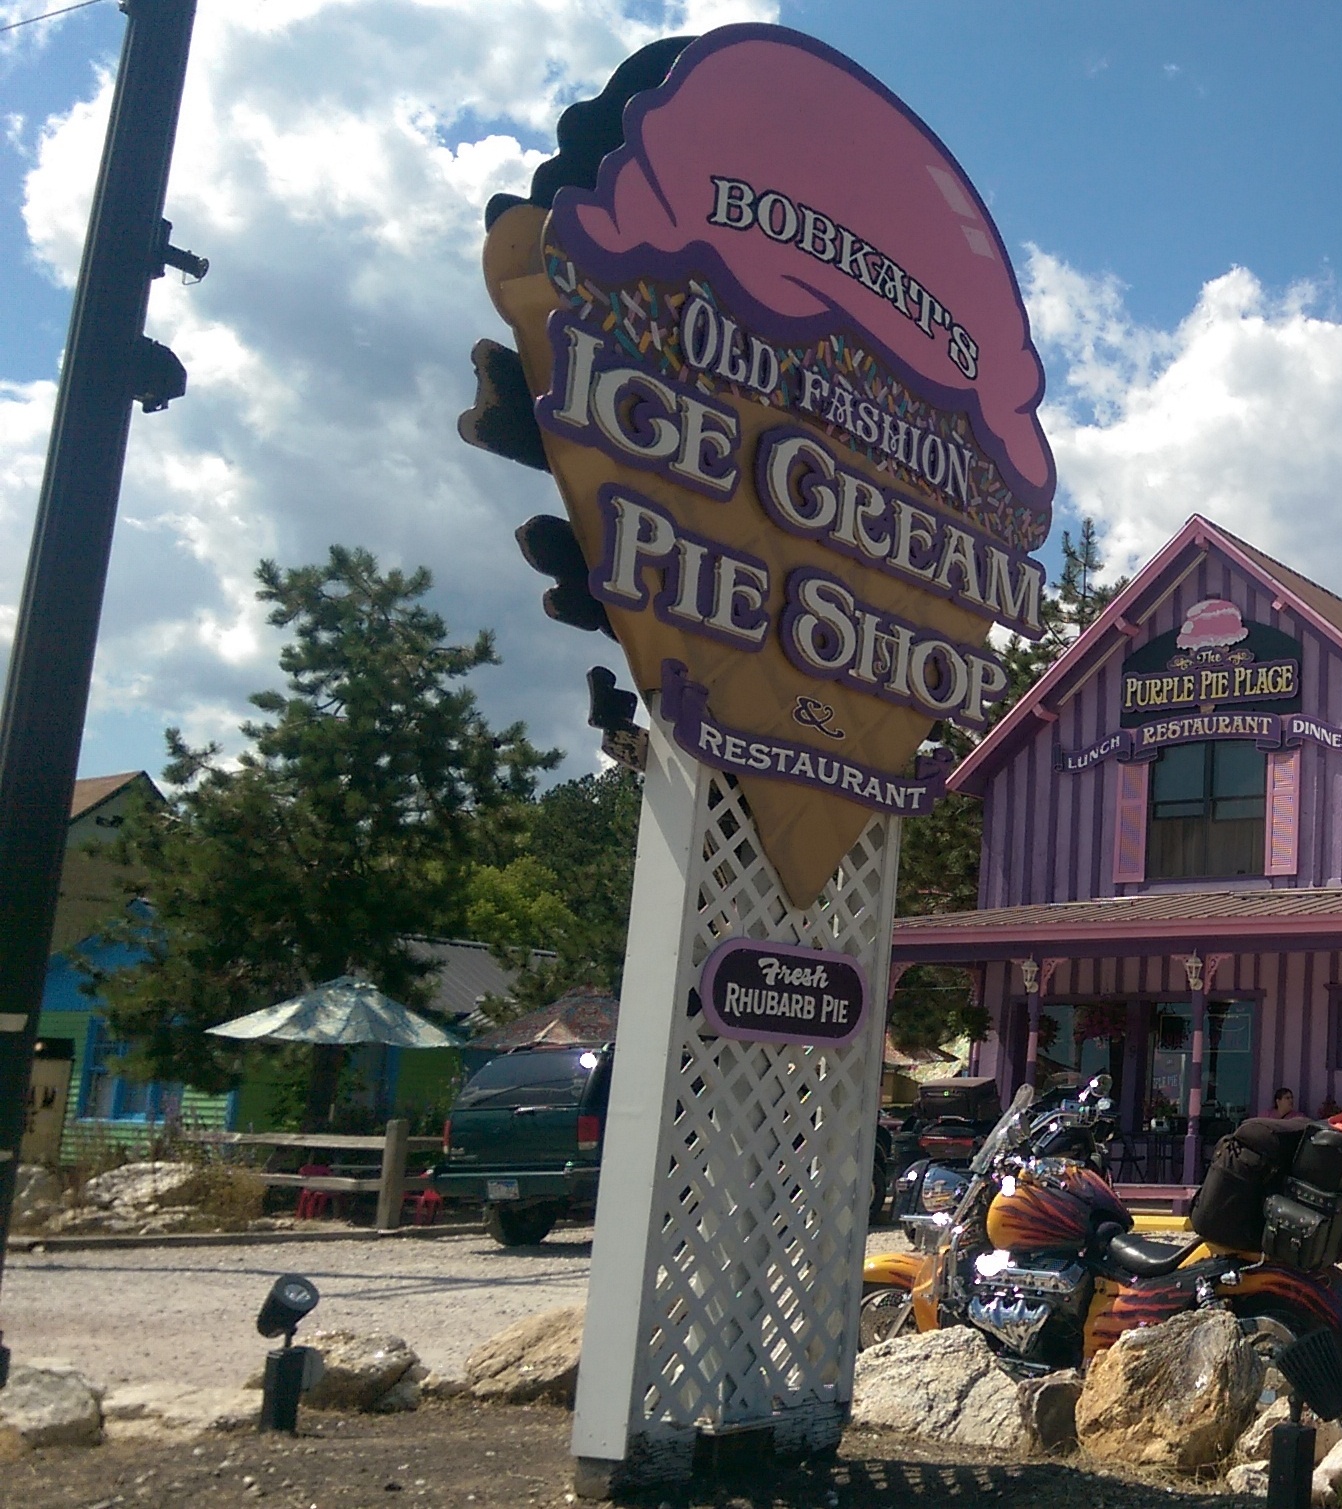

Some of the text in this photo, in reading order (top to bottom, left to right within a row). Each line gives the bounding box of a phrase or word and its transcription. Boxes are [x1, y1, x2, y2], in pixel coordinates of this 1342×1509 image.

[708, 177, 979, 380] BOBKAT'S
[683, 297, 975, 496] OLD FASHION
[553, 324, 1043, 633] ICE CREAM
[603, 496, 1008, 721] PIE SHOP
[1196, 650, 1223, 664] The
[1125, 664, 1294, 707] PURPLE PIE PLACE
[792, 695, 846, 740] &
[1142, 716, 1273, 745] RESTAURANT
[698, 721, 927, 810] RESTAURANT
[1067, 735, 1121, 769] LUNCH
[758, 957, 829, 989] Fresh
[724, 982, 849, 1024] RHUBARB PIE
